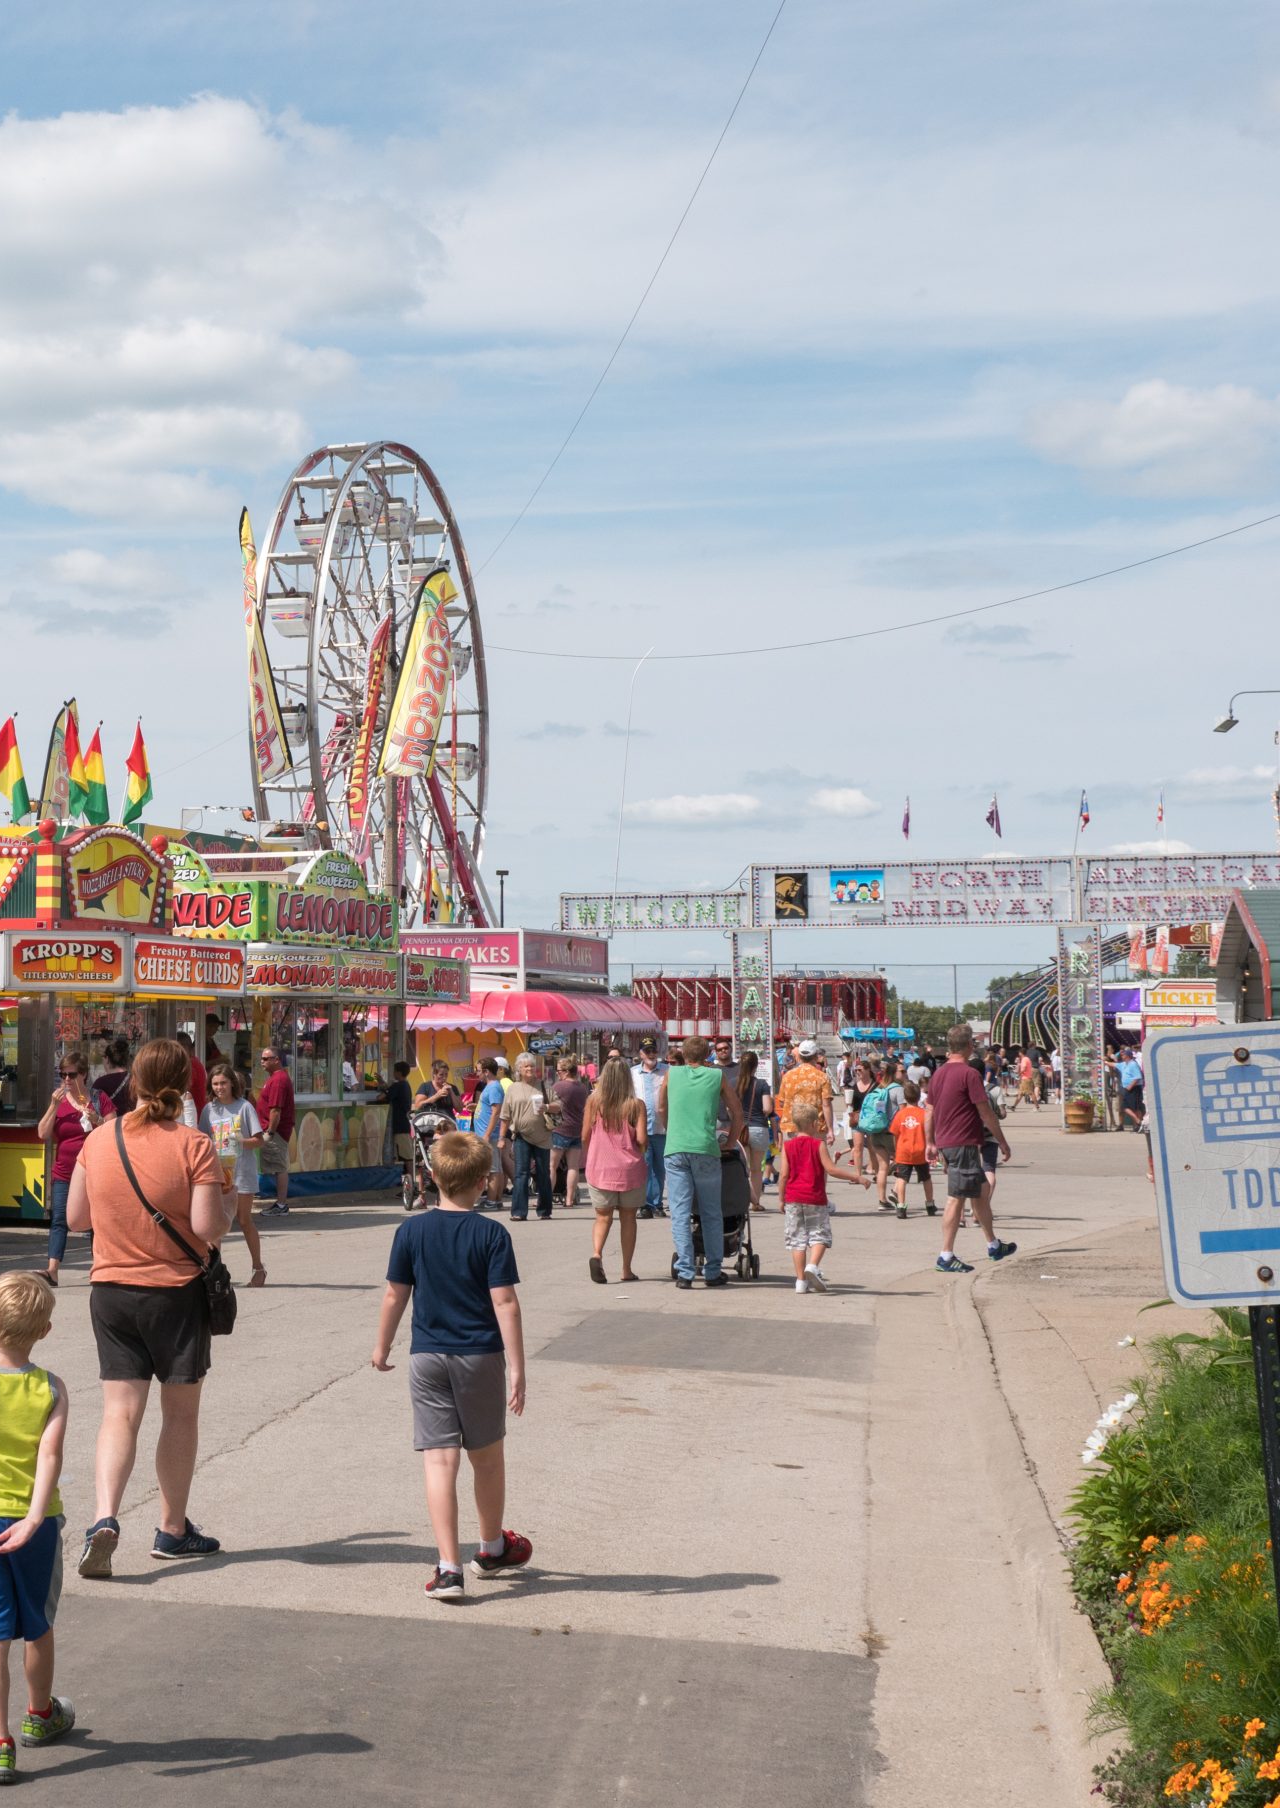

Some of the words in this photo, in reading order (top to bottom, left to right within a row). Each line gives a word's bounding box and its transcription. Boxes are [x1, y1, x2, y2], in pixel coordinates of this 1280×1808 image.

[81, 865, 122, 895] MOZZARELLA
[122, 861, 147, 882] STICKS
[325, 861, 351, 875] FRESH
[1086, 864, 1280, 885] AMERICA
[316, 874, 359, 890] SQUEEZED
[911, 869, 1043, 889] NORTH
[173, 893, 252, 929] NADE
[276, 891, 393, 941] LEMONADE
[575, 900, 741, 926] WELCOME
[891, 898, 1054, 917] MIDWAY
[404, 936, 453, 945] PENNSYLVANIA
[454, 936, 479, 945] DUTCH
[21, 942, 114, 965] KROPP'S
[150, 945, 188, 960] Freshly
[190, 947, 231, 961] Battered
[246, 953, 279, 963] FRESH
[450, 946, 511, 964] CAKES
[545, 943, 571, 965] FUNNEL
[571, 947, 593, 967] CAKES
[22, 971, 76, 981] TITLETOWN
[77, 972, 113, 981] CHEESE
[137, 957, 192, 983] CHEESE
[194, 959, 240, 986] CURDS
[337, 964, 398, 991] LEMONADE
